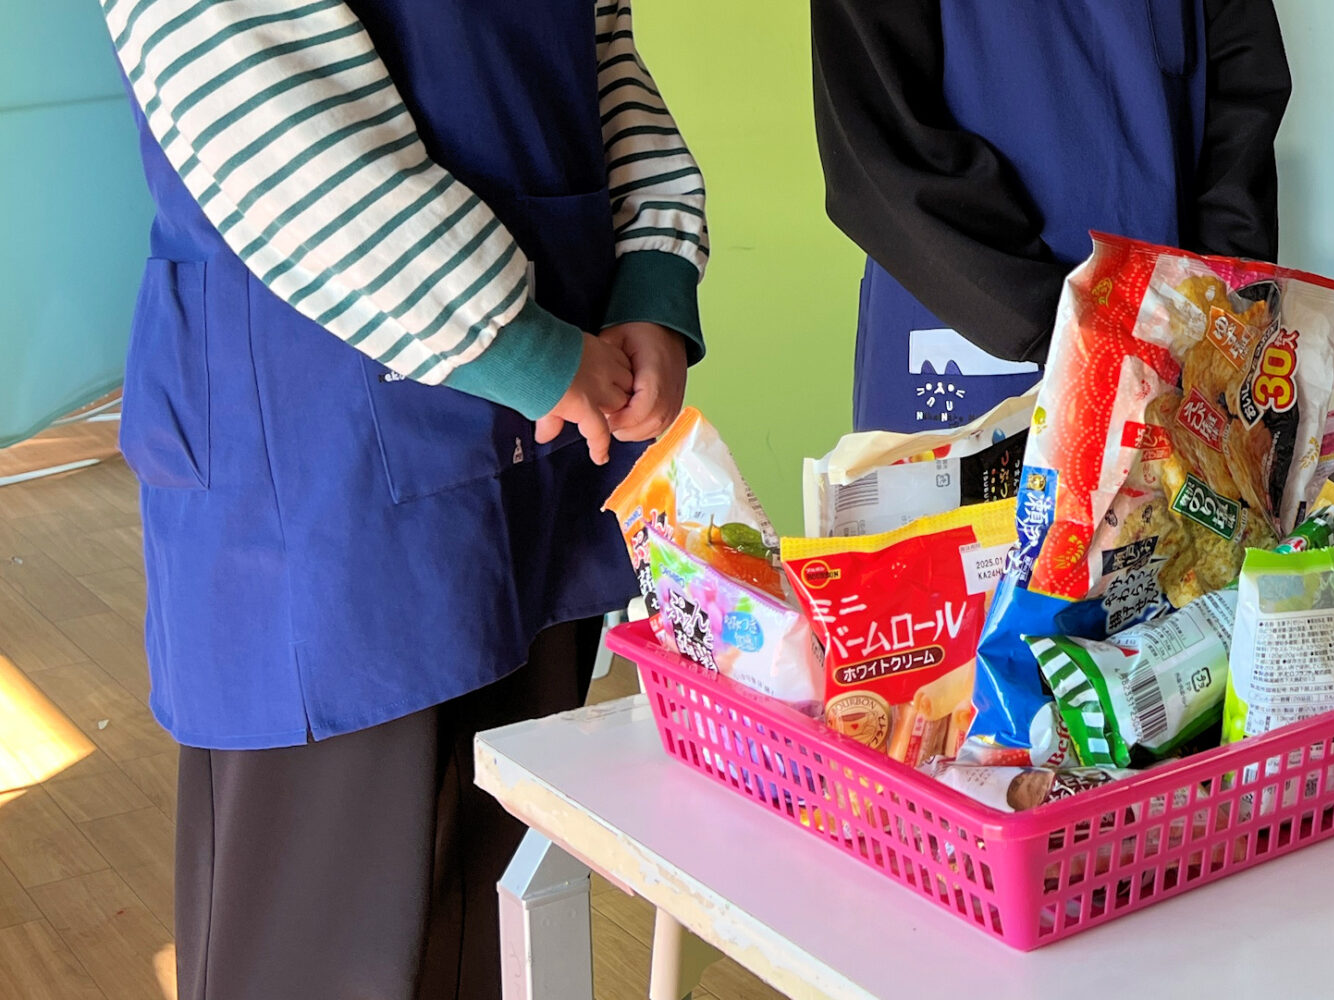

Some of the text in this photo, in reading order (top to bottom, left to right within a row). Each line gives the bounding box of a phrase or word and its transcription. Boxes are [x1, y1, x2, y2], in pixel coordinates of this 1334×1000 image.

[810, 594, 868, 623] ミニ
[824, 601, 967, 659] バームロール
[843, 649, 935, 683] ホワイトクリーム
